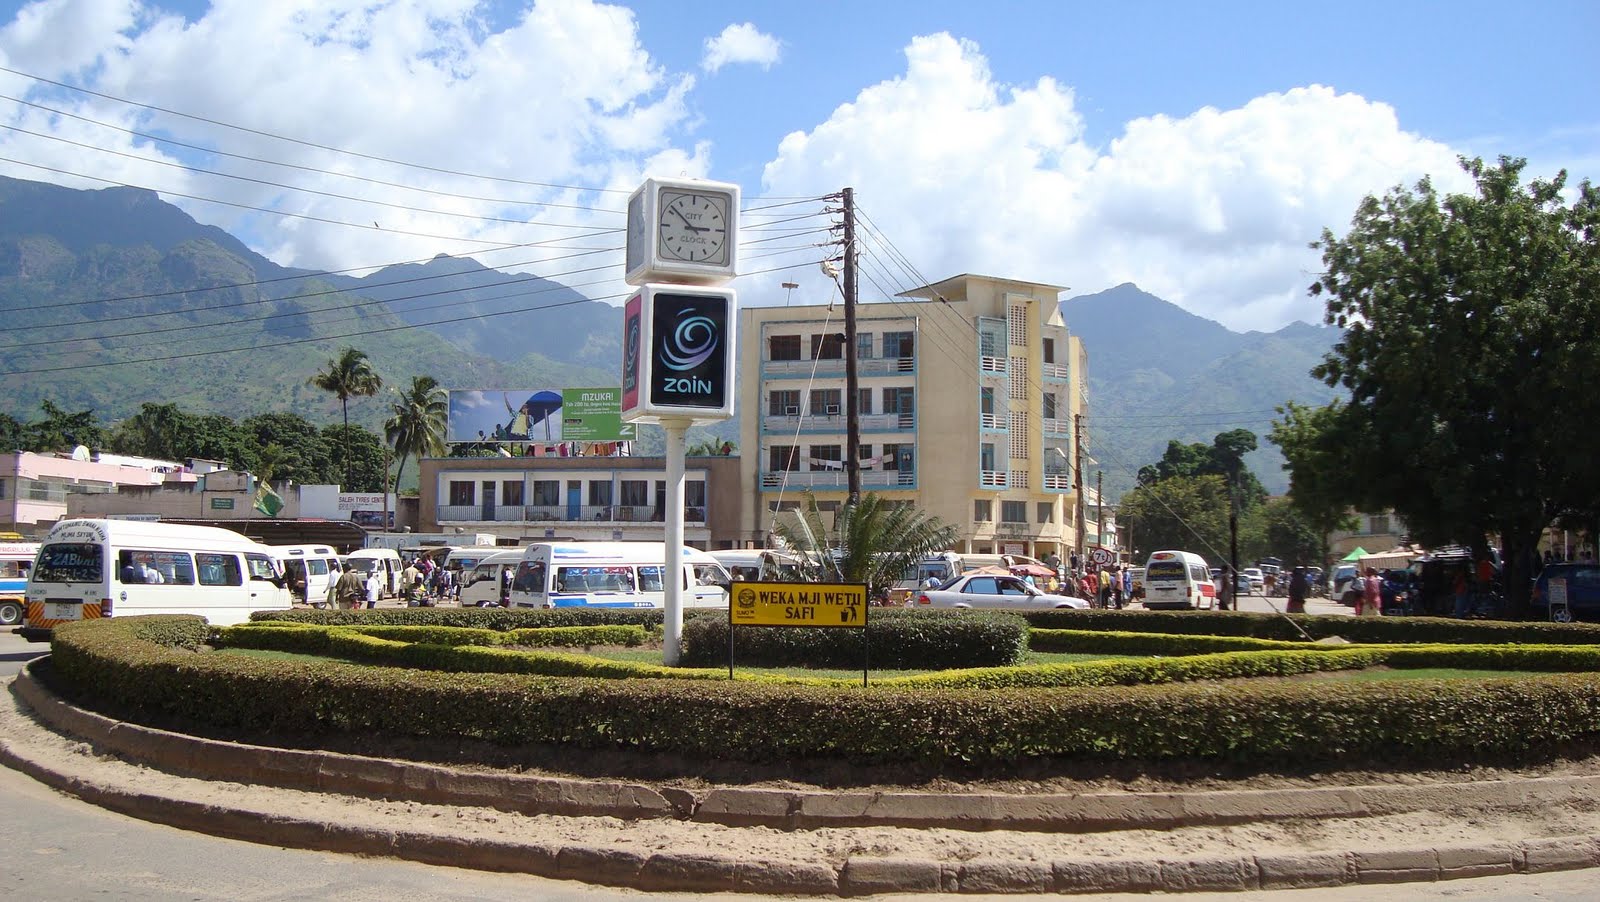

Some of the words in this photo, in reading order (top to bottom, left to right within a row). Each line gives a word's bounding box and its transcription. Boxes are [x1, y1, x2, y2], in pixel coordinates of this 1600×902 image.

[680, 236, 706, 244] CLOCK
[759, 591, 795, 604] WEKA
[798, 592, 820, 605] MJI
[824, 592, 861, 606] WETU
[785, 606, 814, 619] SAFI
